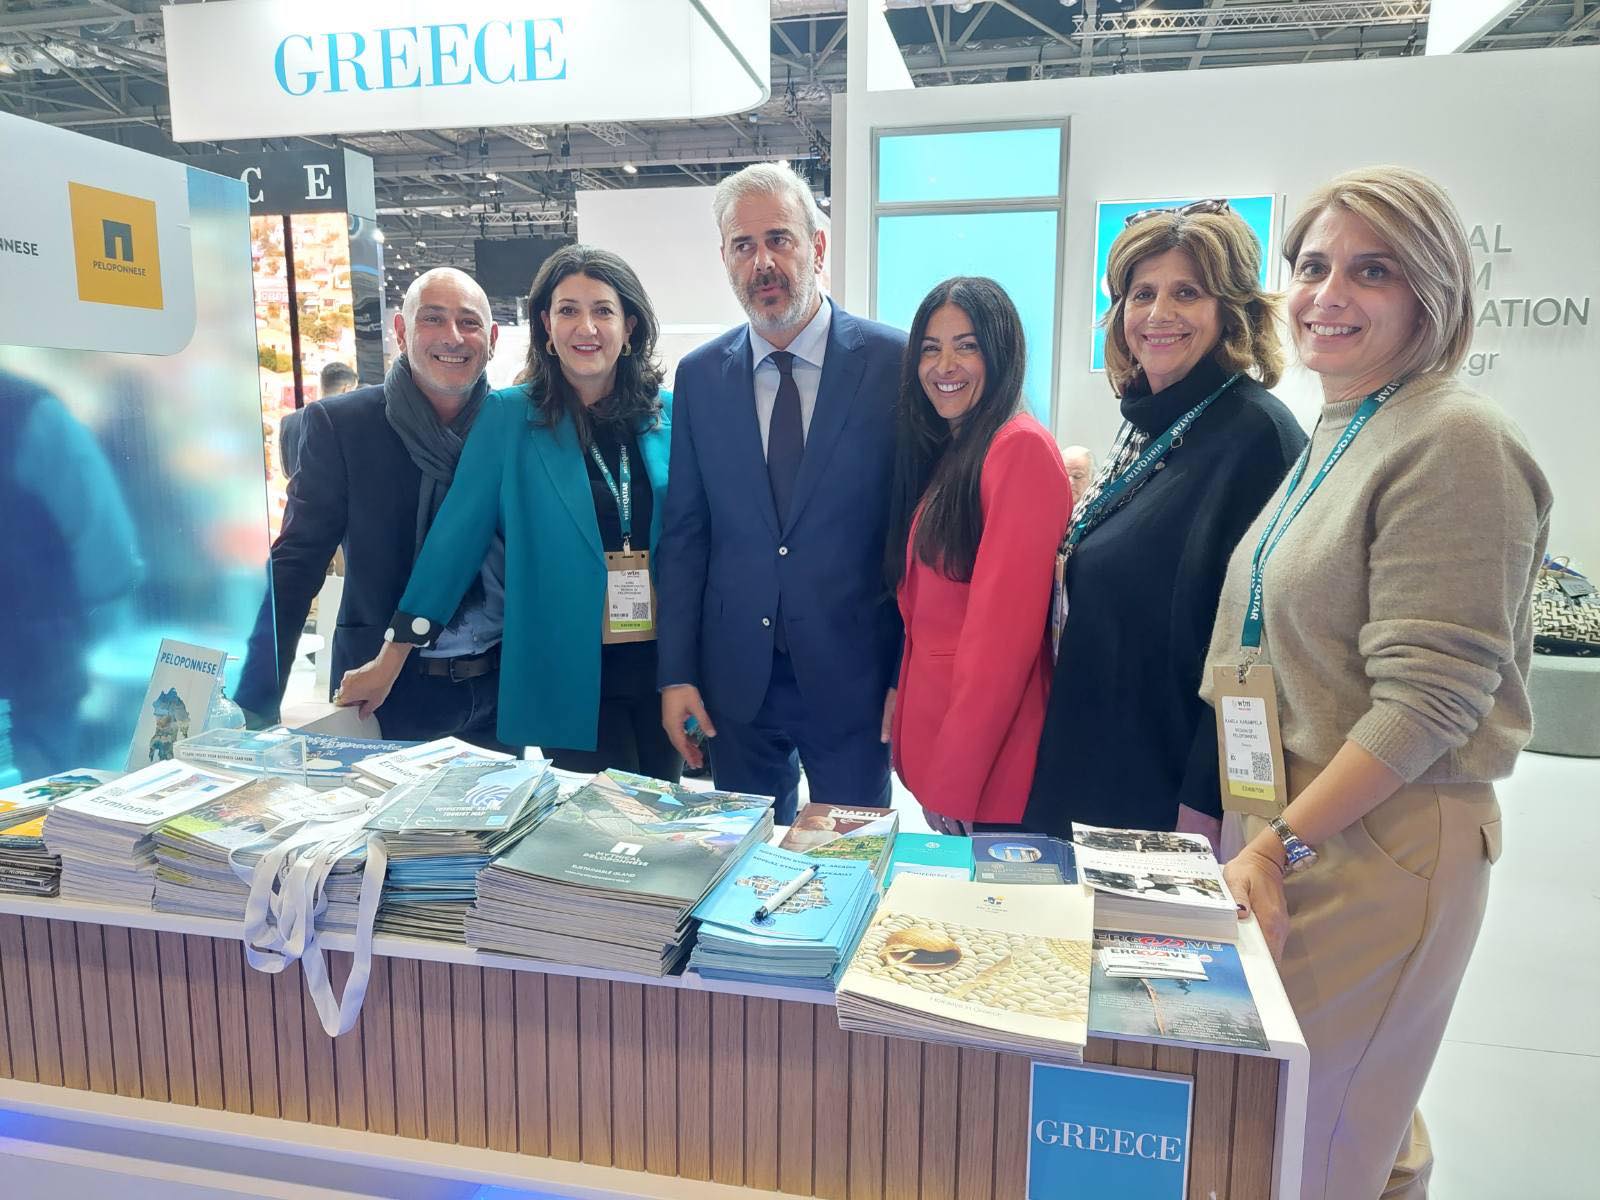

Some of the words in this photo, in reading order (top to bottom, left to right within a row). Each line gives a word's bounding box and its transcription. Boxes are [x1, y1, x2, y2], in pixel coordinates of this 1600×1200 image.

[274, 17, 568, 97] GREECE
[92, 260, 146, 276] PELOPONNESE
[1476, 297, 1590, 327] ATION
[161, 652, 217, 675] PELOPONNESE
[90, 796, 164, 817] Ermionida
[1035, 1119, 1182, 1162] GREECE
